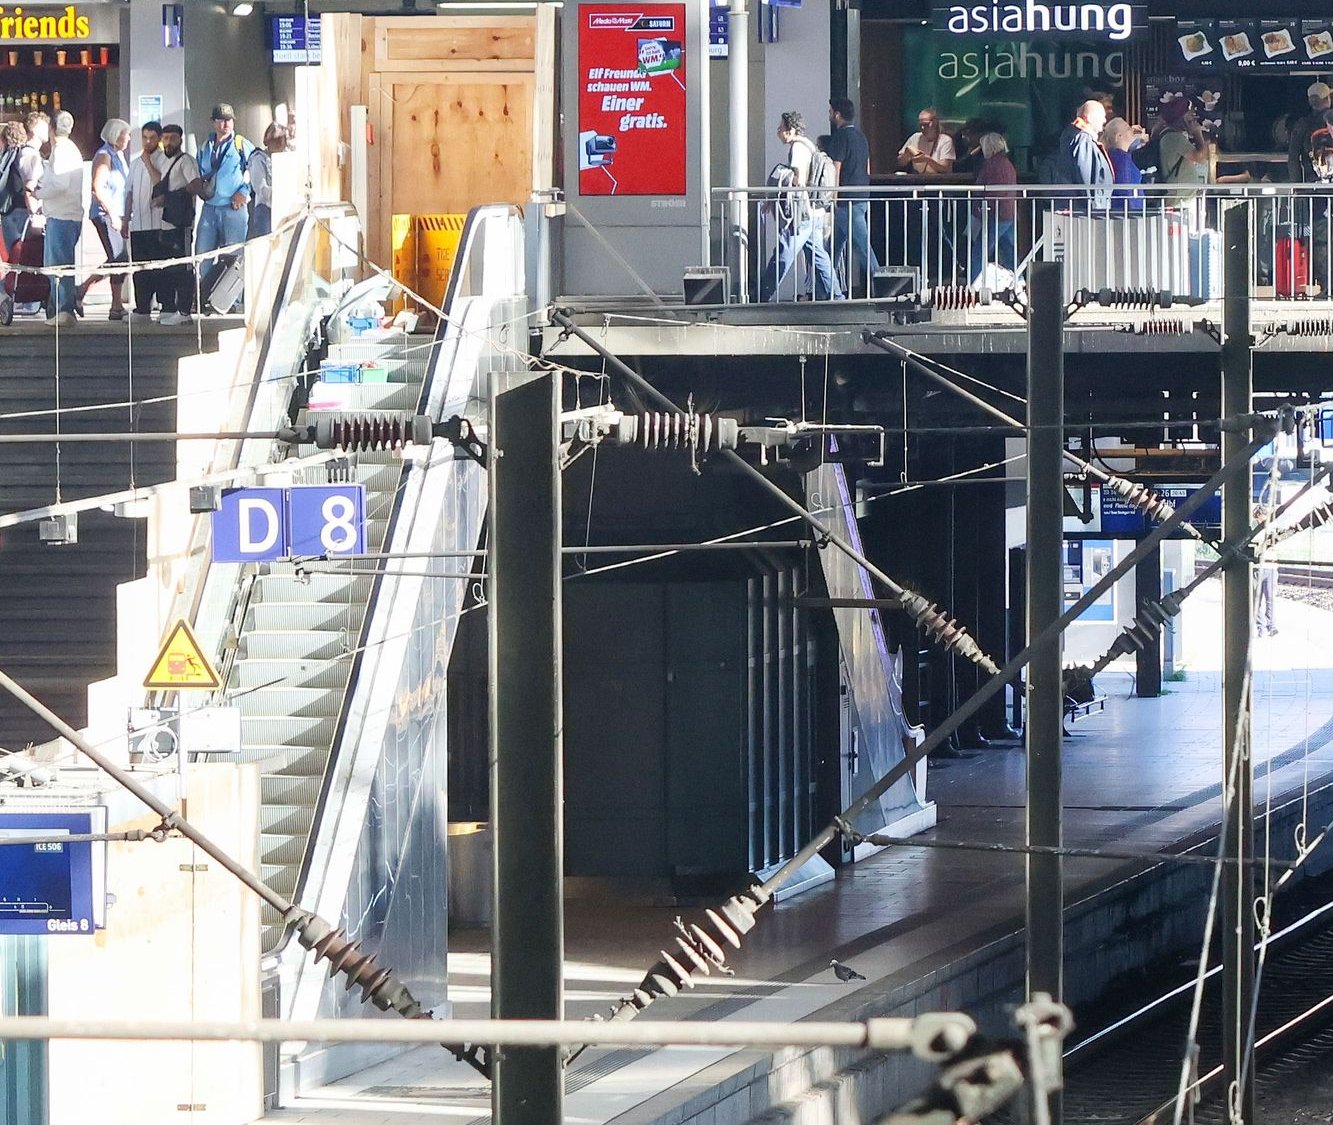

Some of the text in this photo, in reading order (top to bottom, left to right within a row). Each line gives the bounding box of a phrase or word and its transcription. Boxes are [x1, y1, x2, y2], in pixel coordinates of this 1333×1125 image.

[0, 6, 90, 38] riends
[948, 0, 1132, 40] asiahung
[588, 67, 603, 78] Elf
[938, 42, 1124, 87] asiahung
[586, 81, 653, 92] schauen WM.
[601, 95, 645, 111] Einer
[619, 112, 668, 131] gratis.
[239, 495, 357, 553] D 8
[36, 843, 62, 851] ICE 506
[47, 918, 89, 931] Gleis 8
